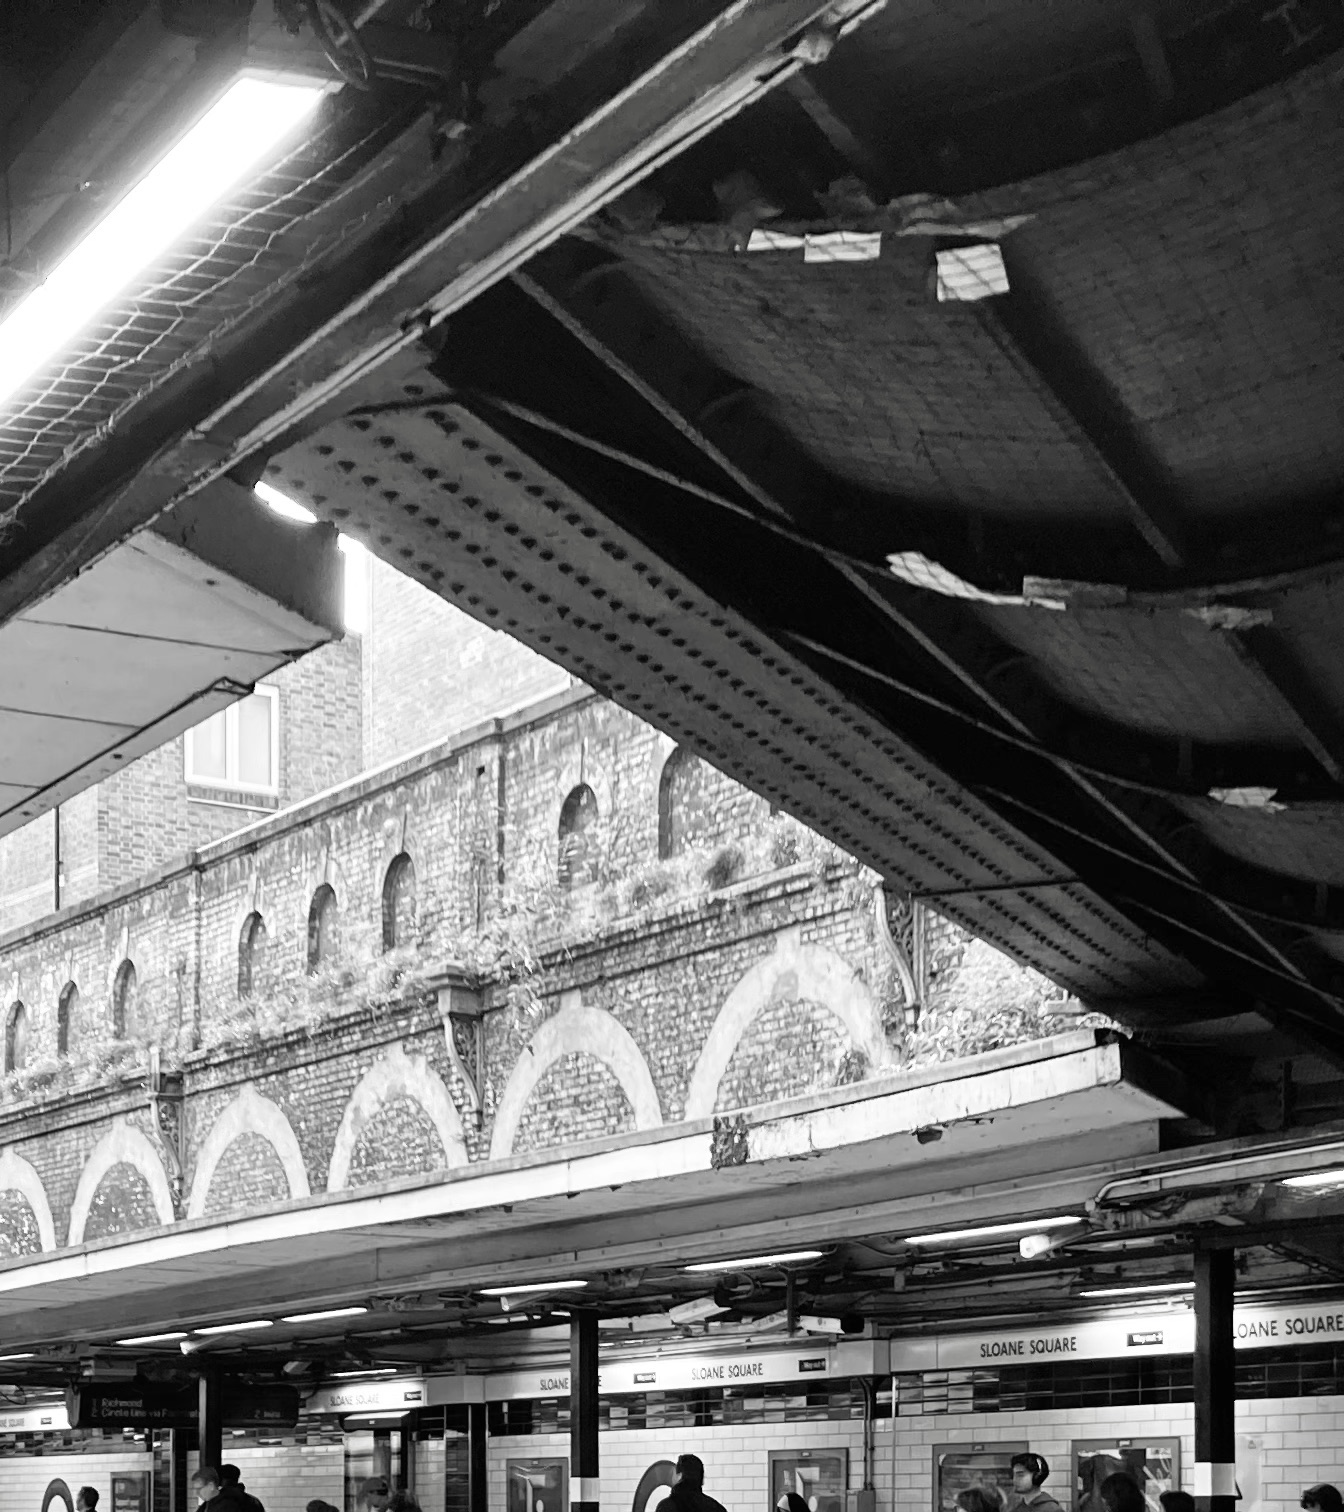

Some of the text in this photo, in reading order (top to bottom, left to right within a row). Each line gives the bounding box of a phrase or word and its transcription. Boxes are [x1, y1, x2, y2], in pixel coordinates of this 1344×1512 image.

[1234, 1314, 1344, 1340] OANE SQUARE
[980, 1336, 1077, 1358] SLOANE SQUARE
[692, 1362, 763, 1380] SLOANE SQUARE
[540, 1377, 569, 1391] SLOANE
